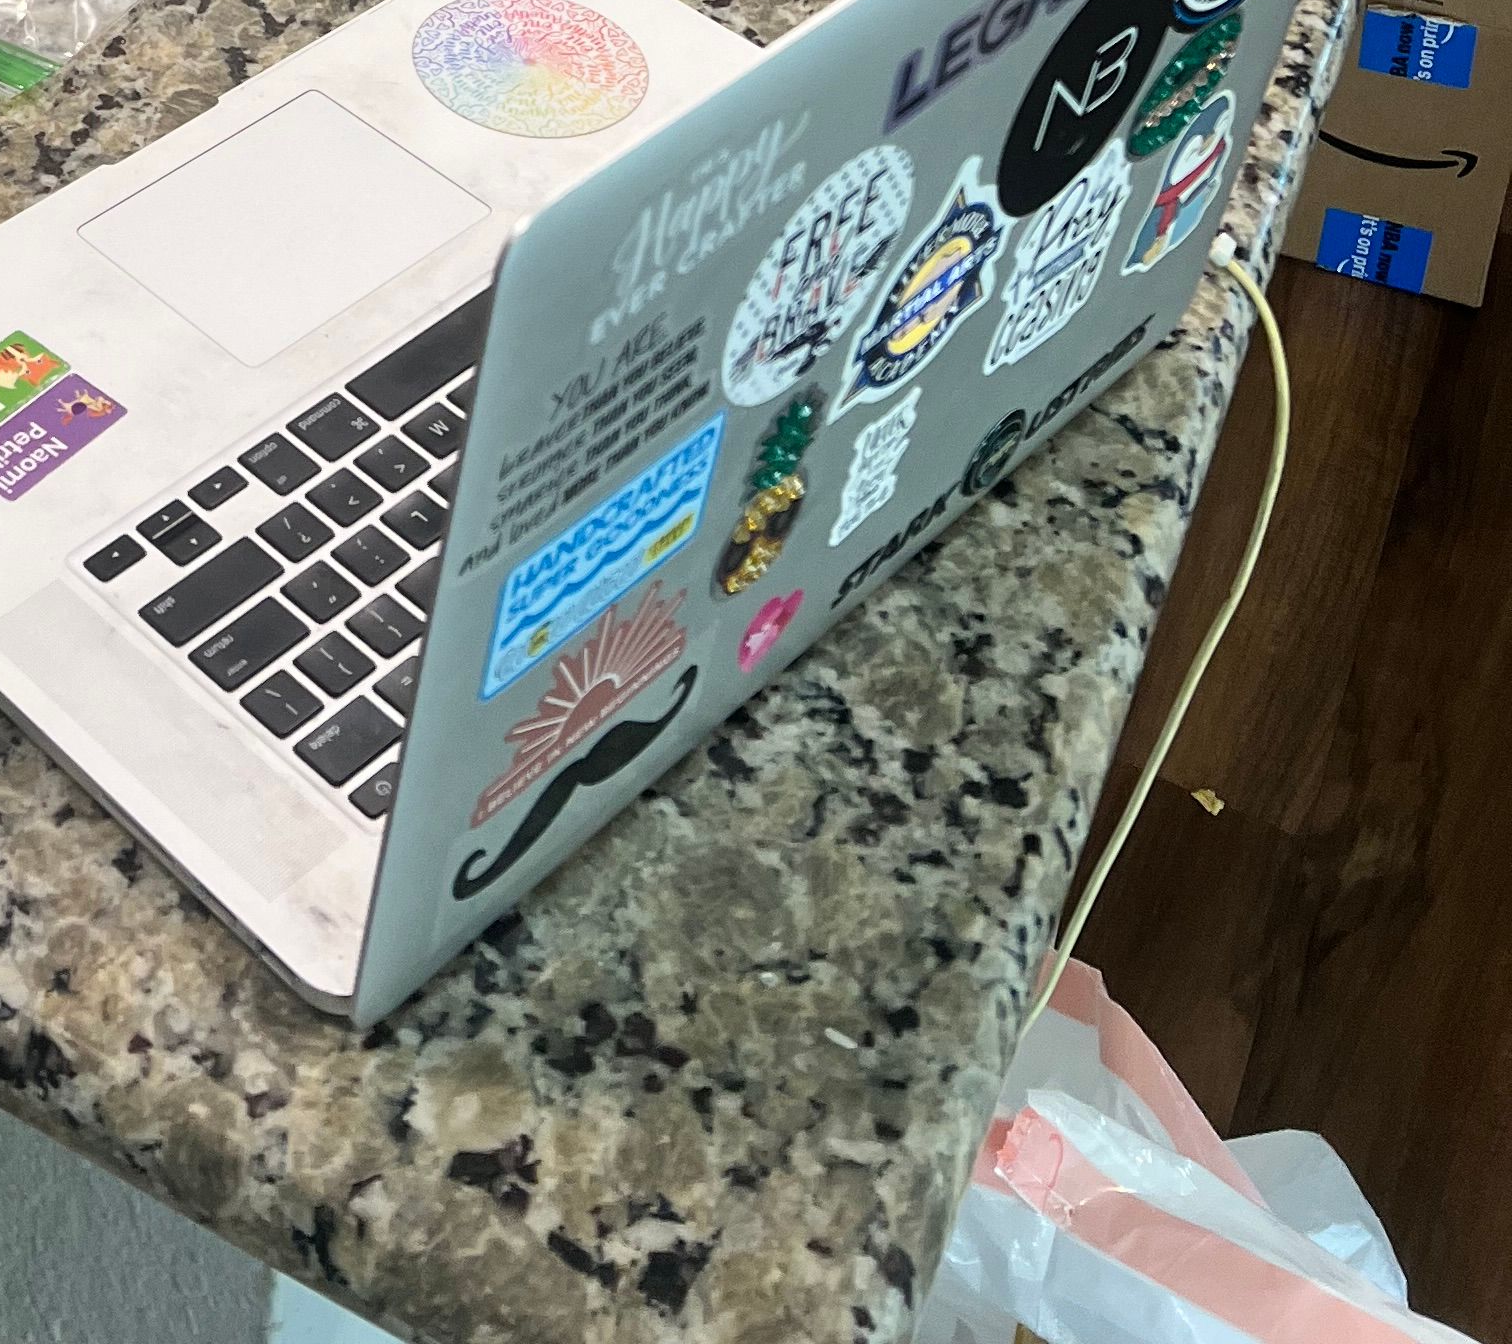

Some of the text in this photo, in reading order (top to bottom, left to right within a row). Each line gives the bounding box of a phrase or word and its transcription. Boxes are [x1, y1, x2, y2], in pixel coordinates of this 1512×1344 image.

[1032, 25, 1139, 153] NB
[1419, 49, 1435, 69] on
[587, 265, 670, 348] EVER
[673, 155, 810, 283] CRAFTER
[612, 111, 809, 297] Happy
[769, 164, 889, 303] FREE
[1355, 237, 1371, 256] on
[1359, 214, 1380, 237] It's
[857, 275, 944, 358] MARTIAL
[941, 230, 1001, 291] ARTS
[296, 394, 343, 433] command
[545, 303, 674, 428] YOU ARE
[504, 553, 579, 626] SUPER
[582, 453, 710, 566] GOODNESS
[510, 422, 718, 600] HANDCRAFTED
[831, 478, 965, 609] STARK
[150, 593, 178, 617] shift
[201, 631, 236, 661] return
[306, 721, 344, 754] delete
